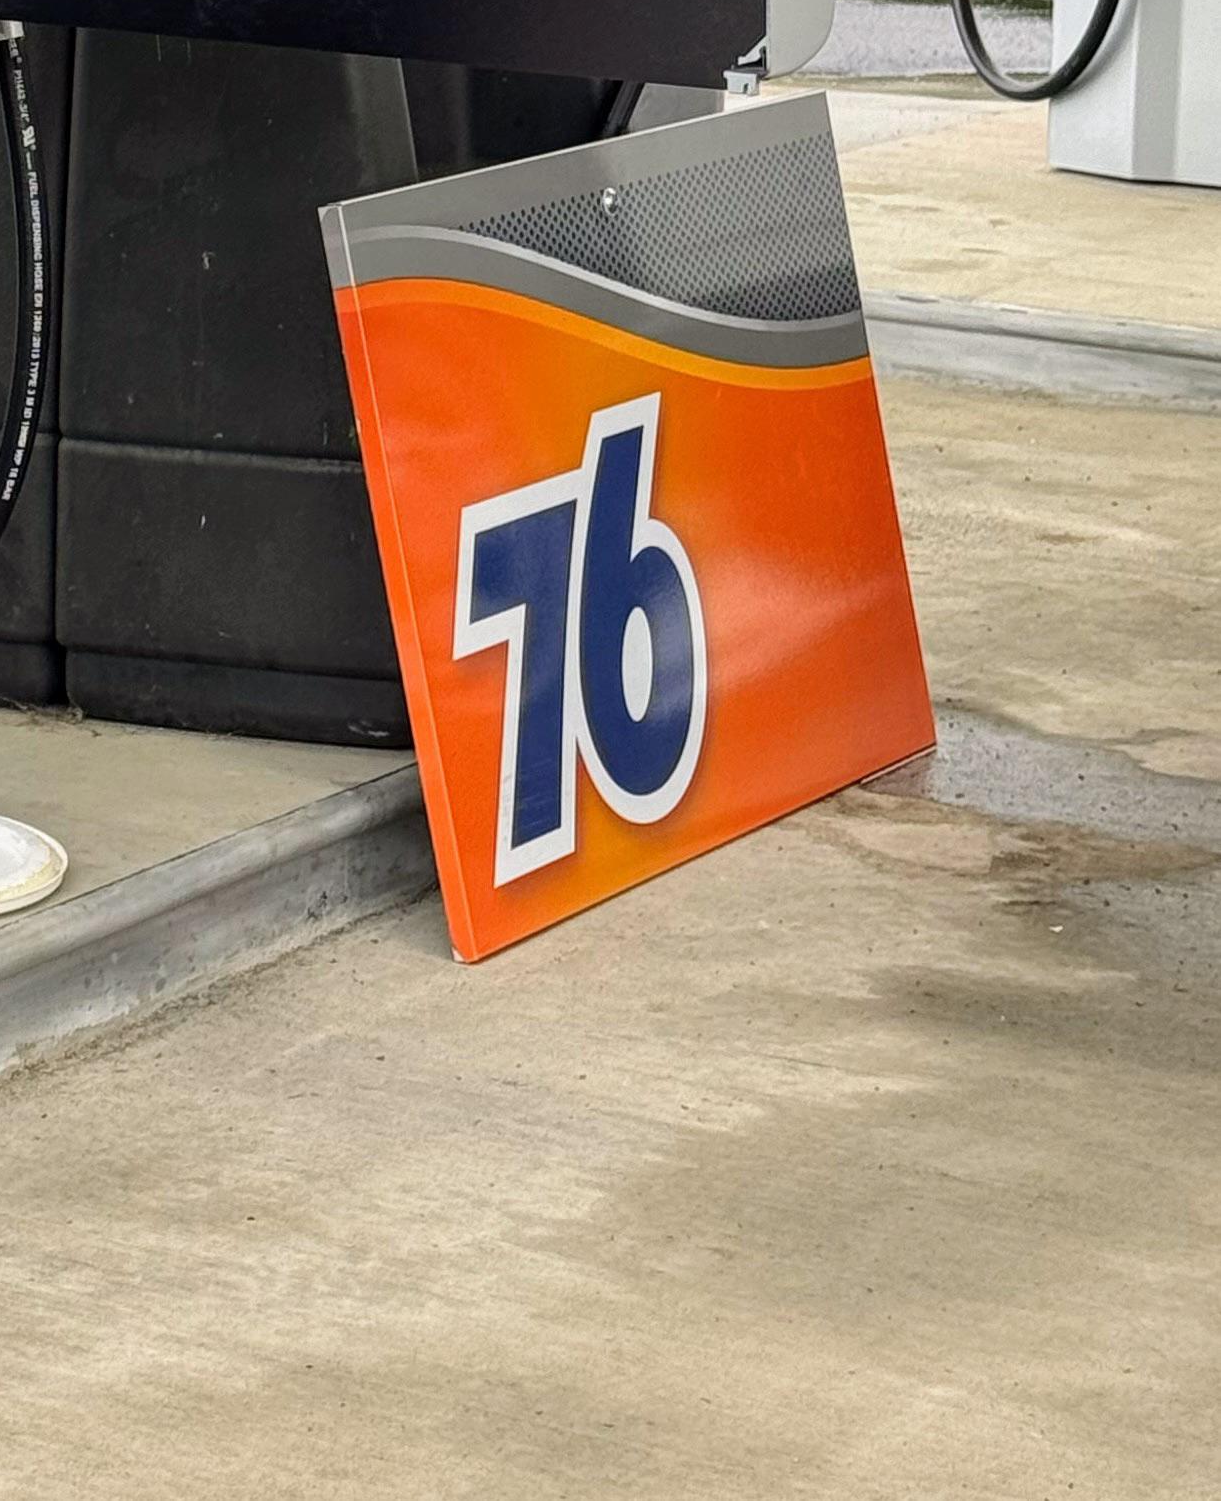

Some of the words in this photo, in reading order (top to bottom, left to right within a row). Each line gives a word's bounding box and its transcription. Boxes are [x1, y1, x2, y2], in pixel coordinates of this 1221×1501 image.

[27, 171, 39, 199] FUEL
[31, 199, 43, 261] DISPENSING
[34, 262, 44, 291] HOSE
[28, 361, 40, 388] TYPE
[451, 390, 708, 886] 76
